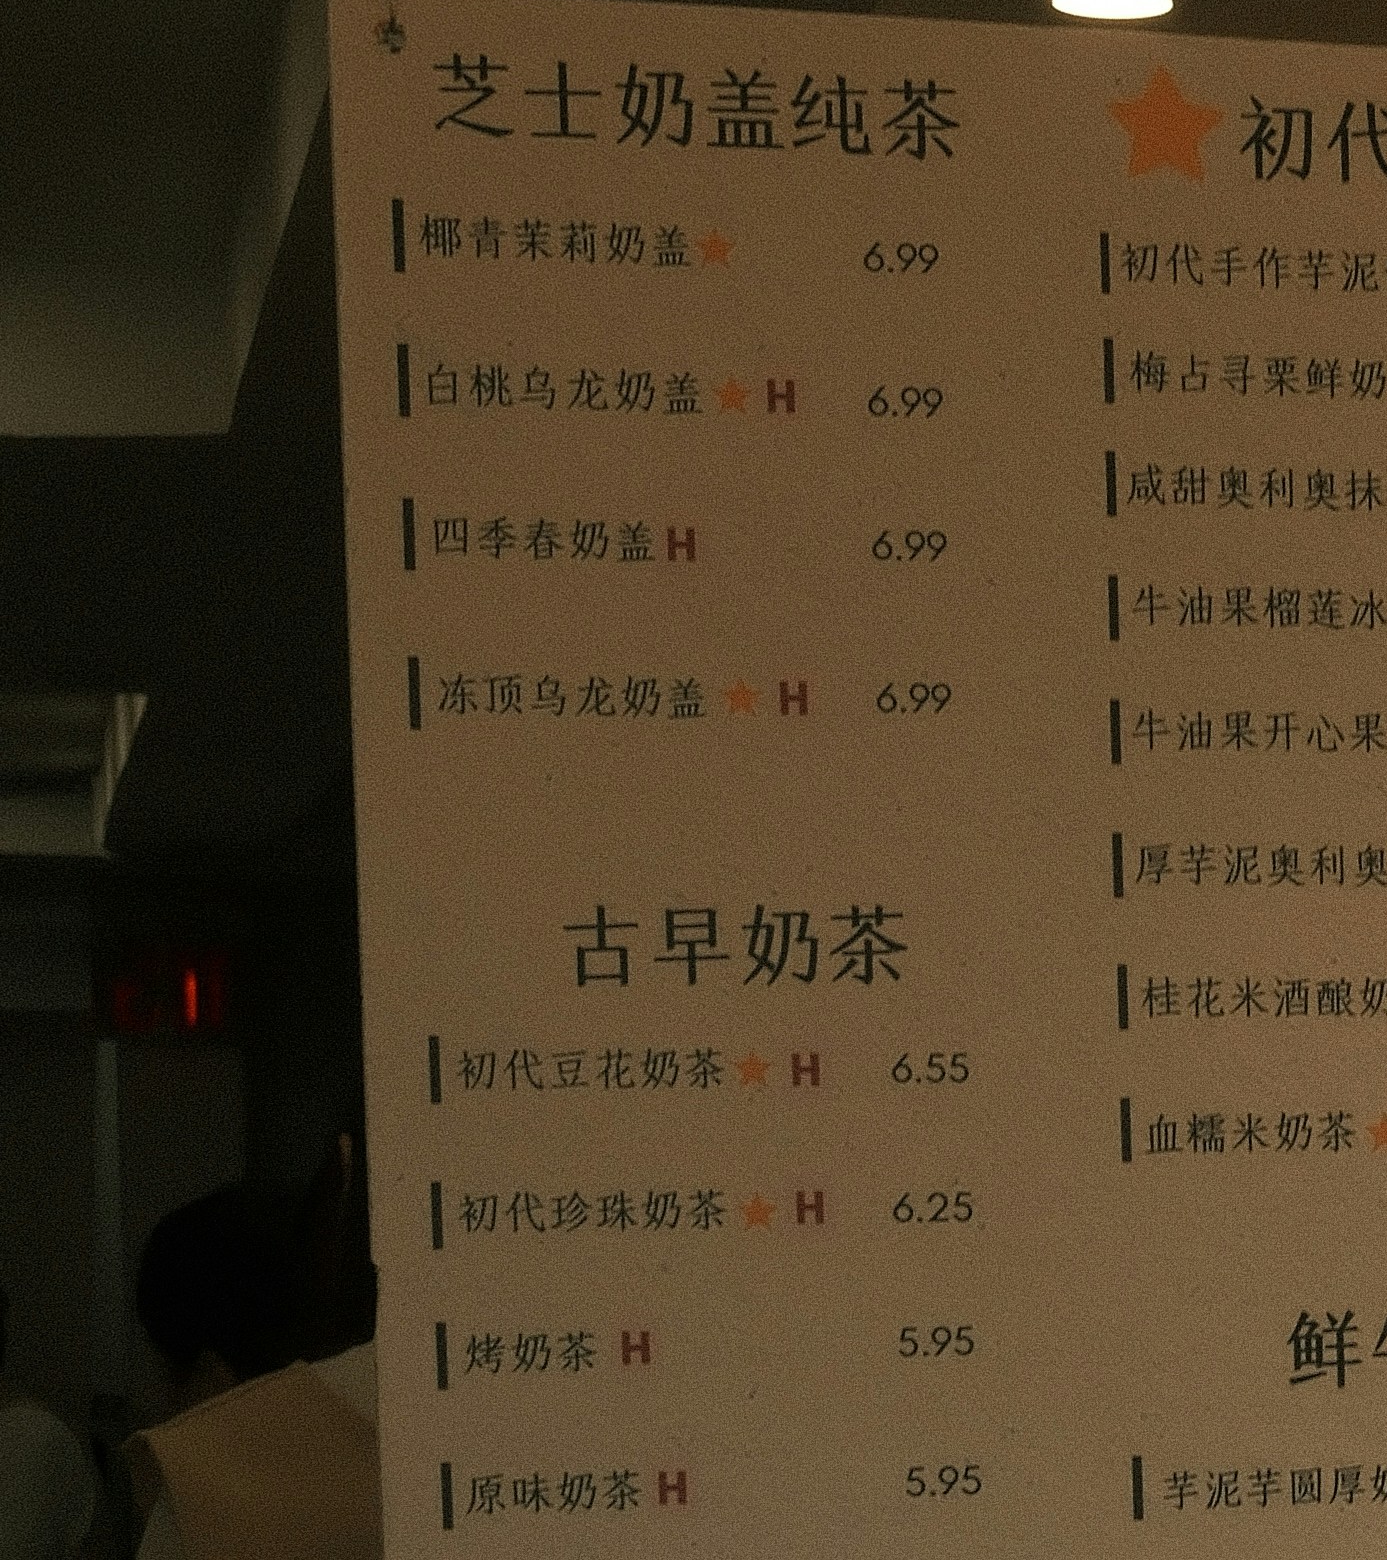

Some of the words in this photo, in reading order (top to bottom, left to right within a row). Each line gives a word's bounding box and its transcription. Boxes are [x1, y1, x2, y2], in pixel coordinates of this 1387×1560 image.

[433, 53, 960, 161] 芝士奶盖纯茶
[422, 214, 691, 267] 椰青茉莉奶盖
[863, 241, 939, 274] 6.99
[428, 362, 702, 415] 白桃乌龙奶盖
[767, 379, 795, 414] H
[867, 386, 944, 418] 6.99
[434, 516, 655, 562] 四季春奶盖
[667, 526, 696, 562] H
[871, 530, 948, 561] 6.99
[439, 673, 706, 719] 冻顶乌龙奶盖
[779, 681, 808, 716] H
[876, 682, 952, 714] 6.99
[564, 904, 907, 987] 古早奶茶
[459, 1047, 724, 1091] 初代豆花奶茶
[791, 1052, 820, 1087] H
[891, 1052, 969, 1084] 6.55
[1147, 1111, 1355, 1154] 血糯米奶茶
[460, 1189, 726, 1233] 初代珍珠奶茶
[796, 1190, 824, 1225] H
[892, 1191, 973, 1223] 6.25
[466, 1330, 596, 1374] 烤奶茶
[621, 1331, 651, 1366] H
[899, 1325, 975, 1358] 5.95
[467, 1469, 640, 1515] 原味奶茶
[658, 1470, 687, 1505] H
[906, 1464, 982, 1498] 5.95
